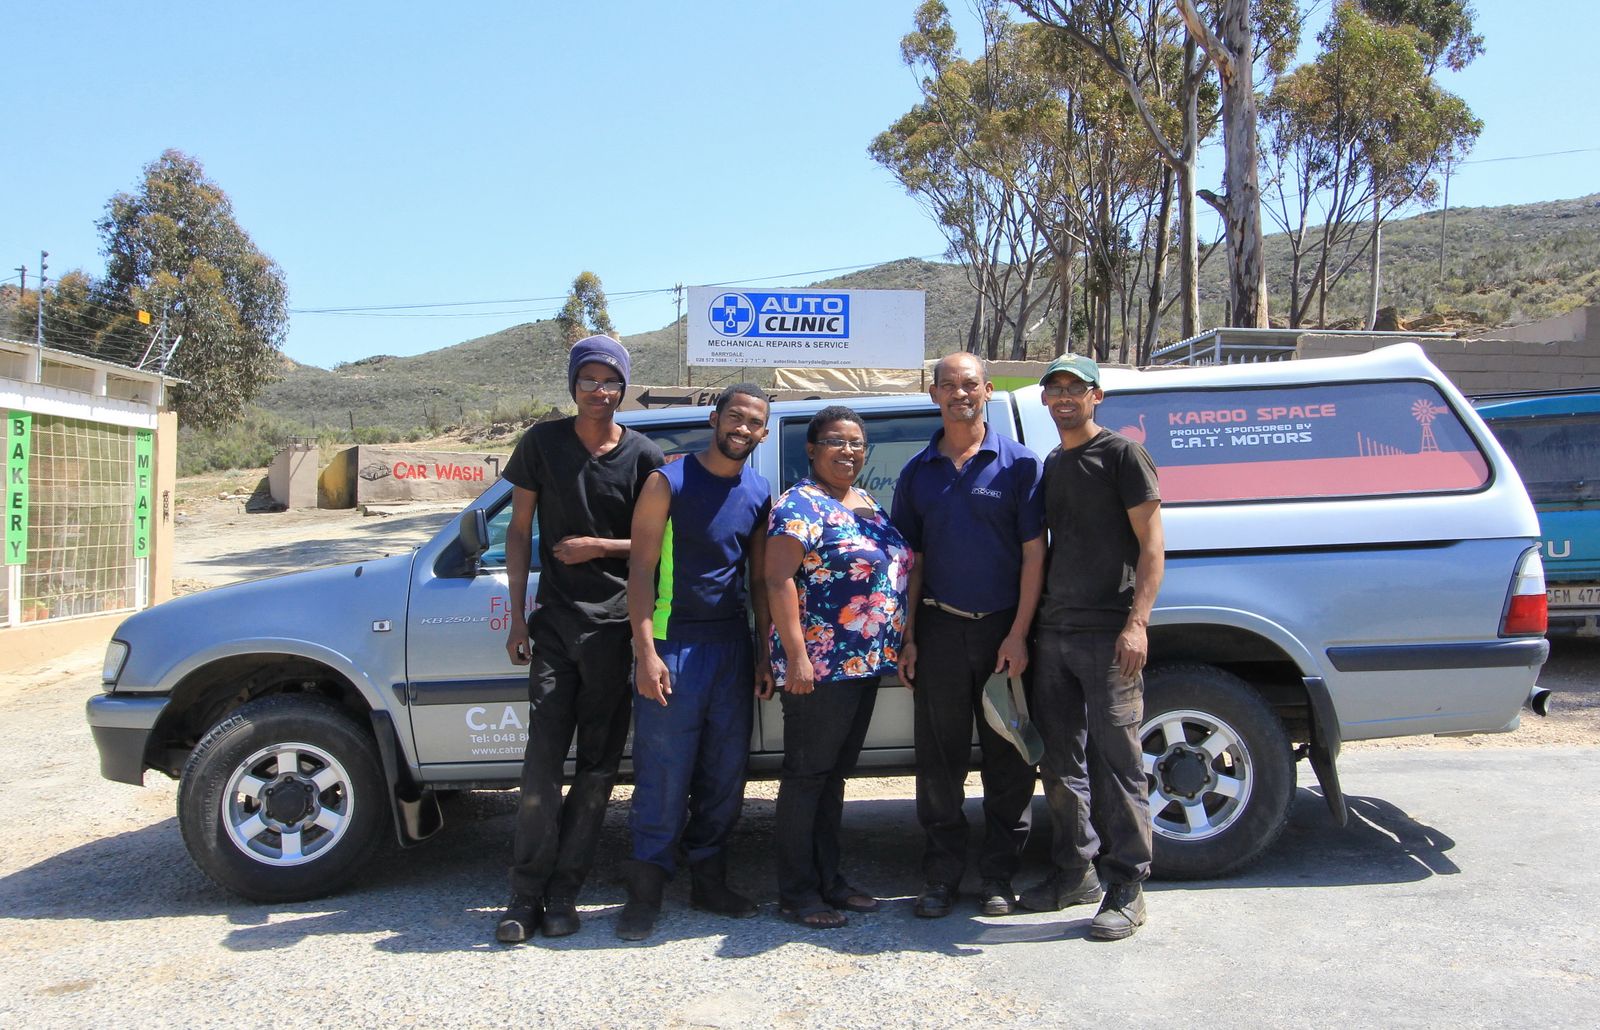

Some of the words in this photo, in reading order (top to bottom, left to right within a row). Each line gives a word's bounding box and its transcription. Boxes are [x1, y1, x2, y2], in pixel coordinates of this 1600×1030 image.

[761, 296, 844, 313] AUTO
[765, 316, 840, 333] CLINIC
[708, 339, 764, 348] MECHANICAL
[766, 341, 803, 349] REPAIRS
[813, 342, 850, 350] SERVICE
[1168, 409, 1248, 425] KAROO
[1257, 404, 1337, 420] SPACE
[1169, 427, 1222, 437] PROUDLY
[1224, 424, 1292, 433] SPONSORED
[1296, 423, 1312, 431] BY
[1171, 437, 1224, 448] C.A.T.
[1231, 432, 1313, 446] MOTORS
[393, 461, 428, 481] CAR
[435, 463, 484, 482] WASH
[11, 418, 25, 559] BAKERY
[138, 454, 149, 550] MEATS
[490, 613, 511, 631] of
[470, 734, 490, 744] Tel:
[492, 733, 516, 743] 048
